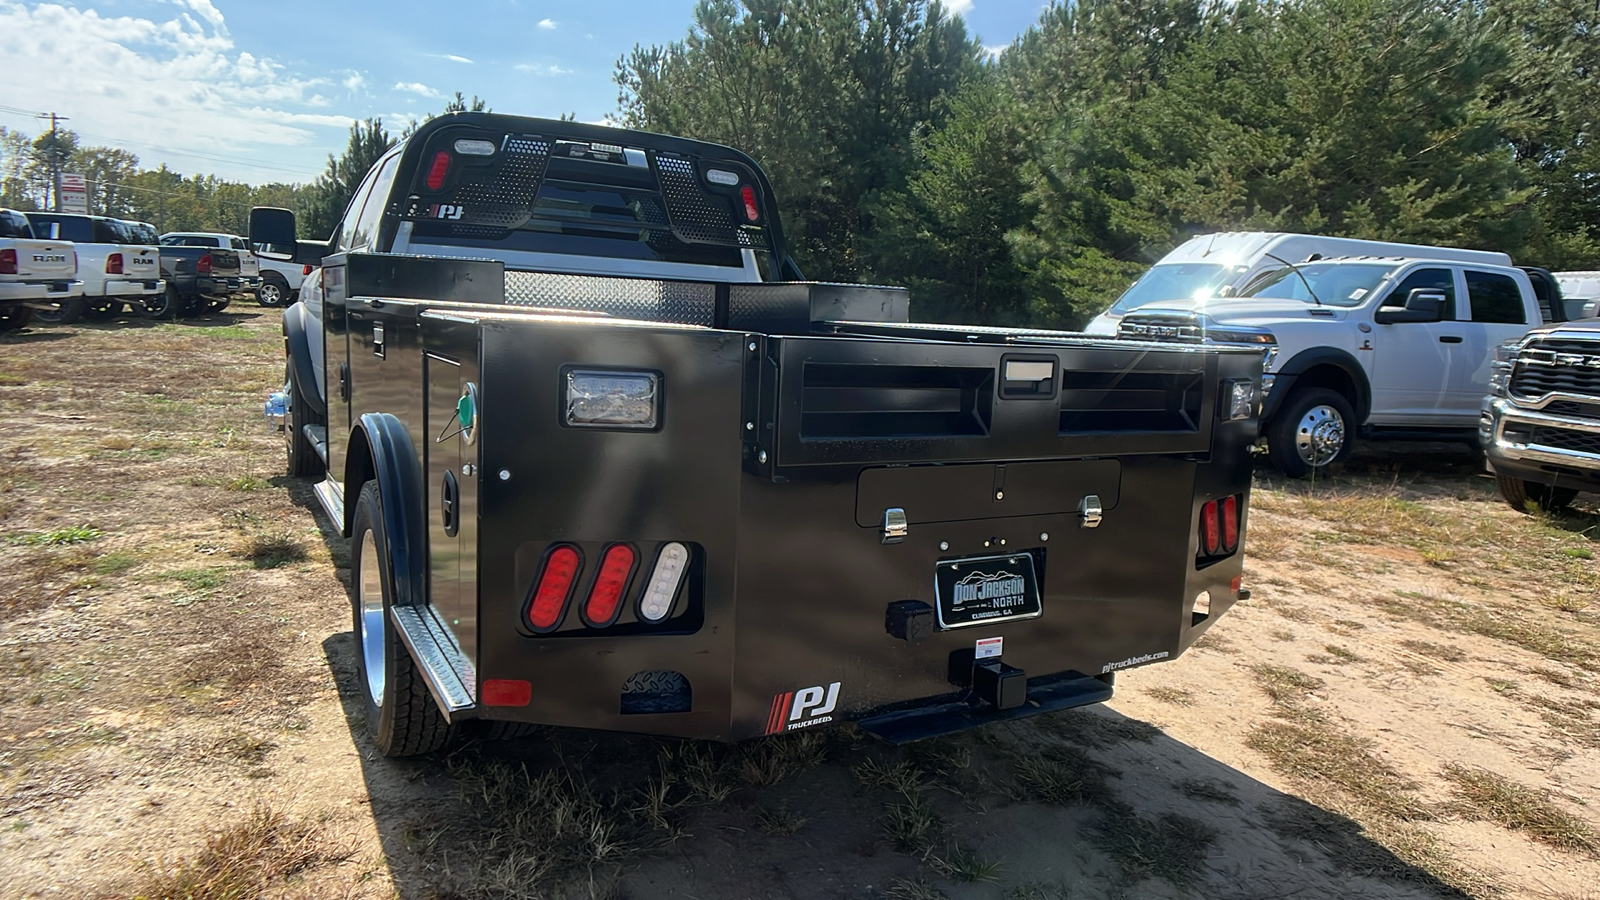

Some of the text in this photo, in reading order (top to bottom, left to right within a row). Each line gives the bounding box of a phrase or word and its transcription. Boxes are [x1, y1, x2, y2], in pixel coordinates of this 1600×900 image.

[438, 204, 463, 219] PJ
[33, 254, 66, 263] RAM
[953, 578, 1024, 604] DON JACKSON
[993, 595, 1024, 608] NORTH
[1102, 651, 1169, 674] pjtruckbeds.com
[789, 681, 841, 721] PJ
[787, 715, 833, 731] TRUCKBEDS
